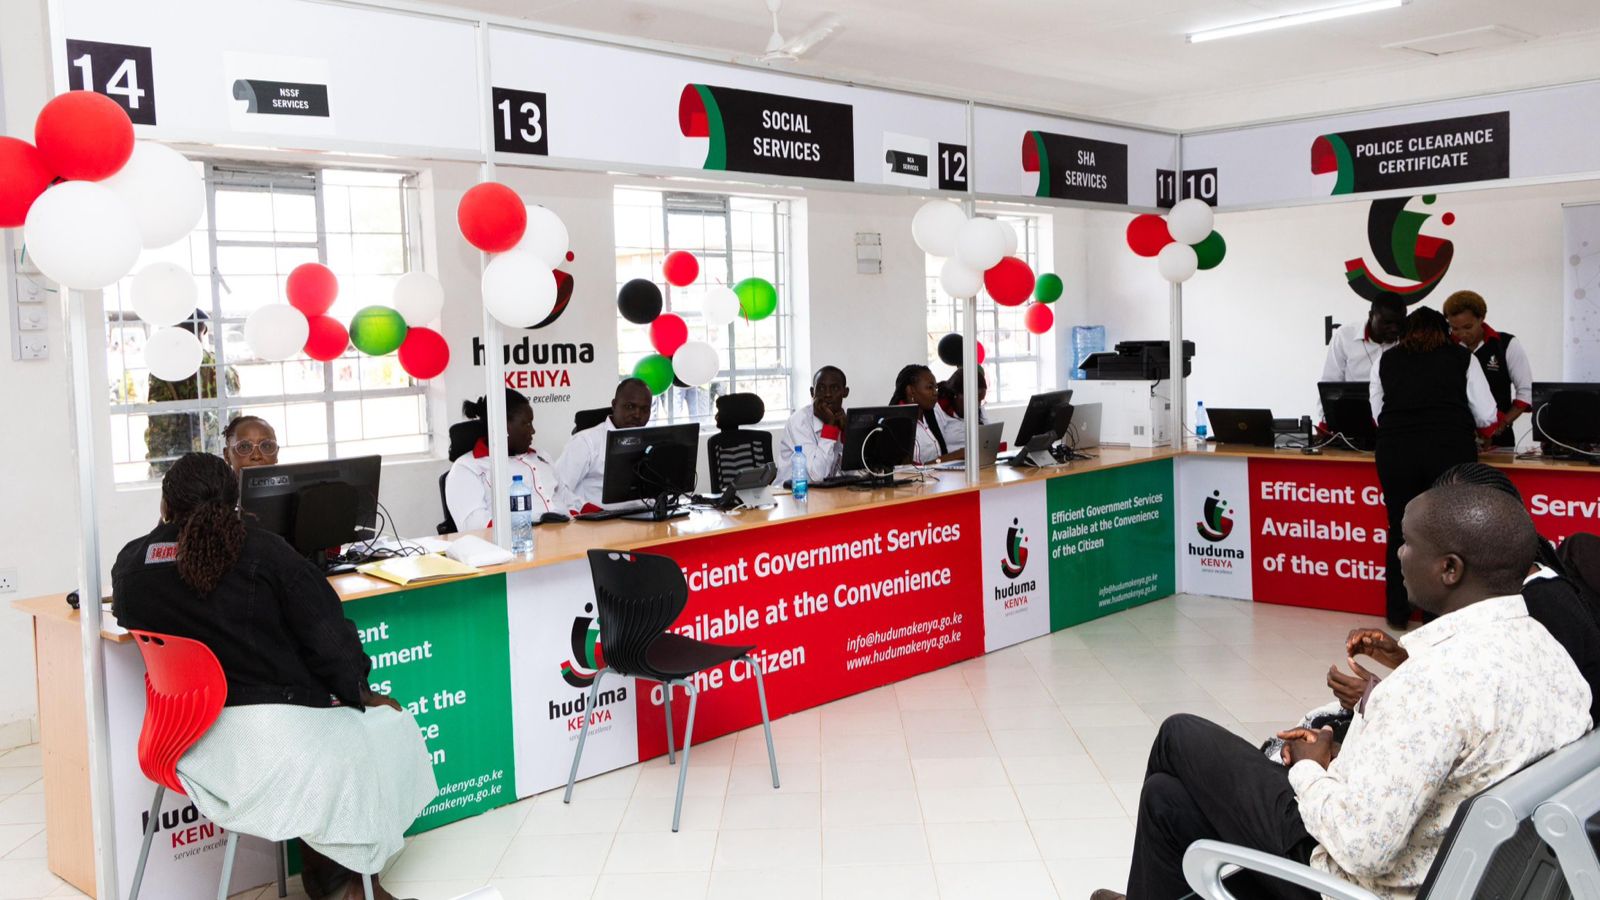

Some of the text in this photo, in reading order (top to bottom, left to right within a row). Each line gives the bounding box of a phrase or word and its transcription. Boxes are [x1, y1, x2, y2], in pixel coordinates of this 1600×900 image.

[73, 53, 145, 109] 14
[279, 87, 300, 98] NSSF
[272, 99, 309, 109] SERVICES
[498, 98, 542, 143] 13
[762, 109, 812, 134] SOCIAL
[753, 136, 820, 161] SERVICES
[1356, 128, 1493, 157] POLICE CLEARANCE
[942, 150, 966, 182] 12
[1077, 150, 1095, 167] SHA
[1378, 151, 1468, 174] CERTIFICATE
[1065, 170, 1107, 190] SERVICES
[1158, 174, 1173, 200] 11
[1186, 173, 1216, 199] 10
[504, 369, 571, 389] KENYA
[532, 393, 571, 403] excellence
[1260, 481, 1355, 505] Efficient
[1052, 492, 1163, 525] Efficient Government Services
[1052, 509, 1159, 542] Available at the Convenience
[1261, 517, 1387, 544] Available a
[754, 532, 882, 578] Government
[887, 521, 960, 551] Services
[1052, 537, 1104, 559] of the Citizen
[1188, 543, 1244, 559] huduma
[1200, 558, 1233, 569] KENYA
[1263, 553, 1386, 581] of the Citiz
[765, 599, 788, 624] at
[793, 591, 829, 618] the
[833, 567, 951, 608] Convenience
[994, 580, 1036, 600] huduma
[1004, 595, 1028, 610] KENYA
[847, 611, 962, 653] info@hudumakenya.go.ke
[846, 629, 961, 671] www.hudumakenya.go.ke
[407, 690, 466, 716] at the
[417, 784, 502, 818] umakenya.go.ke
[171, 822, 224, 849] KEN
[173, 847, 201, 862] service
